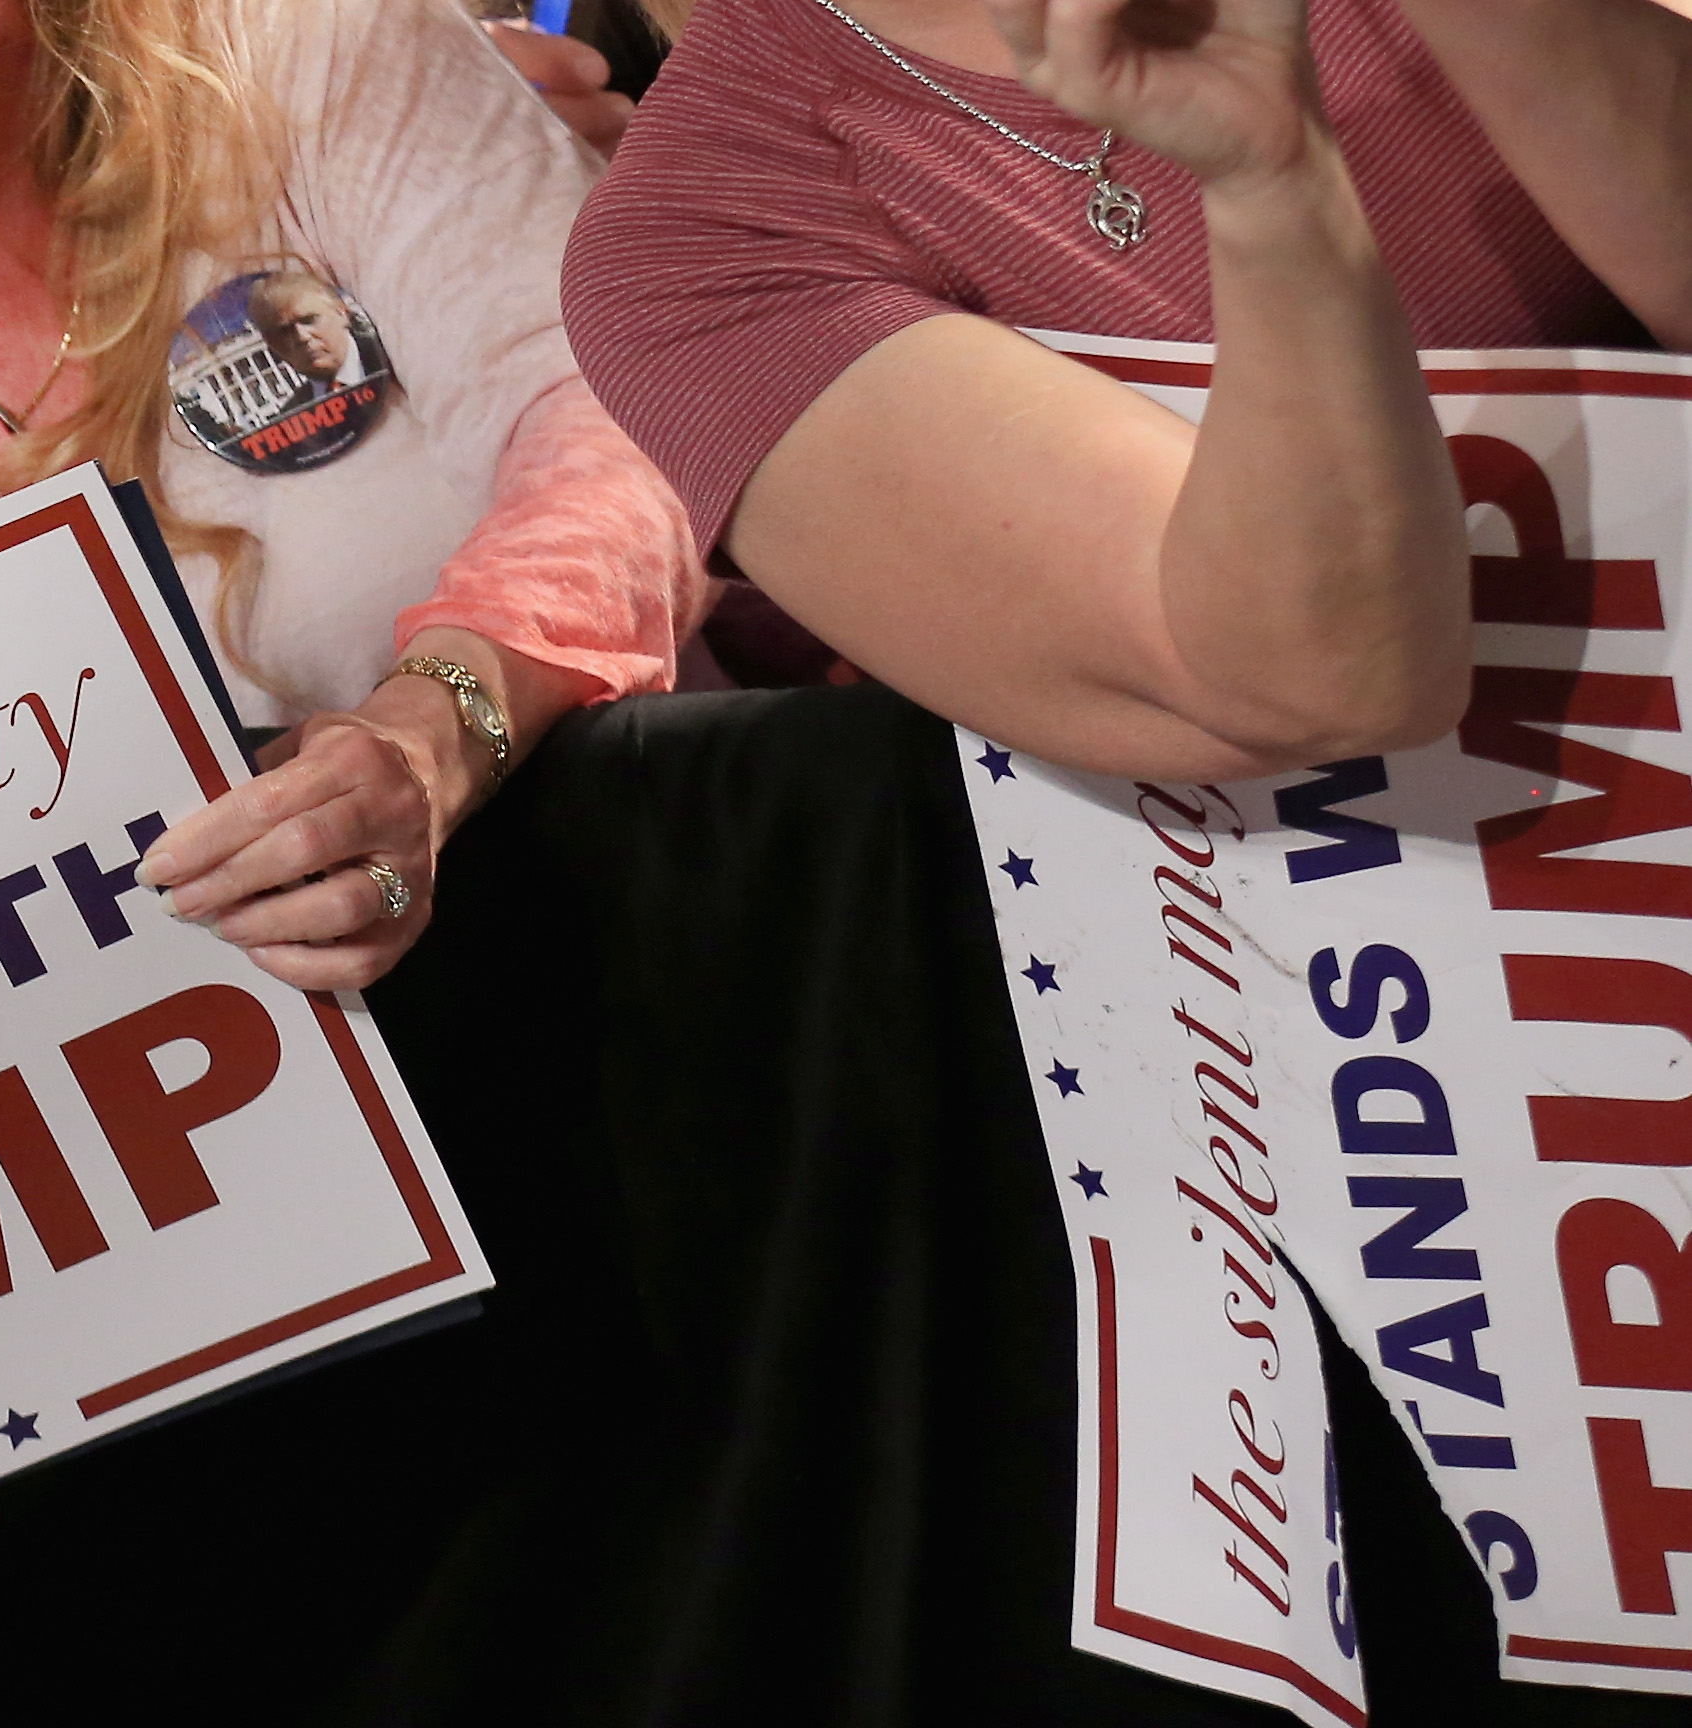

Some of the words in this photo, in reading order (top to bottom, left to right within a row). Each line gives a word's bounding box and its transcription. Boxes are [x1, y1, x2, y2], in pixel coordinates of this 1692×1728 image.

[240, 396, 348, 460] TRUMP
[1445, 432, 1692, 1615] TRUMP
[1171, 996, 1282, 1381] silent
[1193, 1387, 1291, 1617] the
